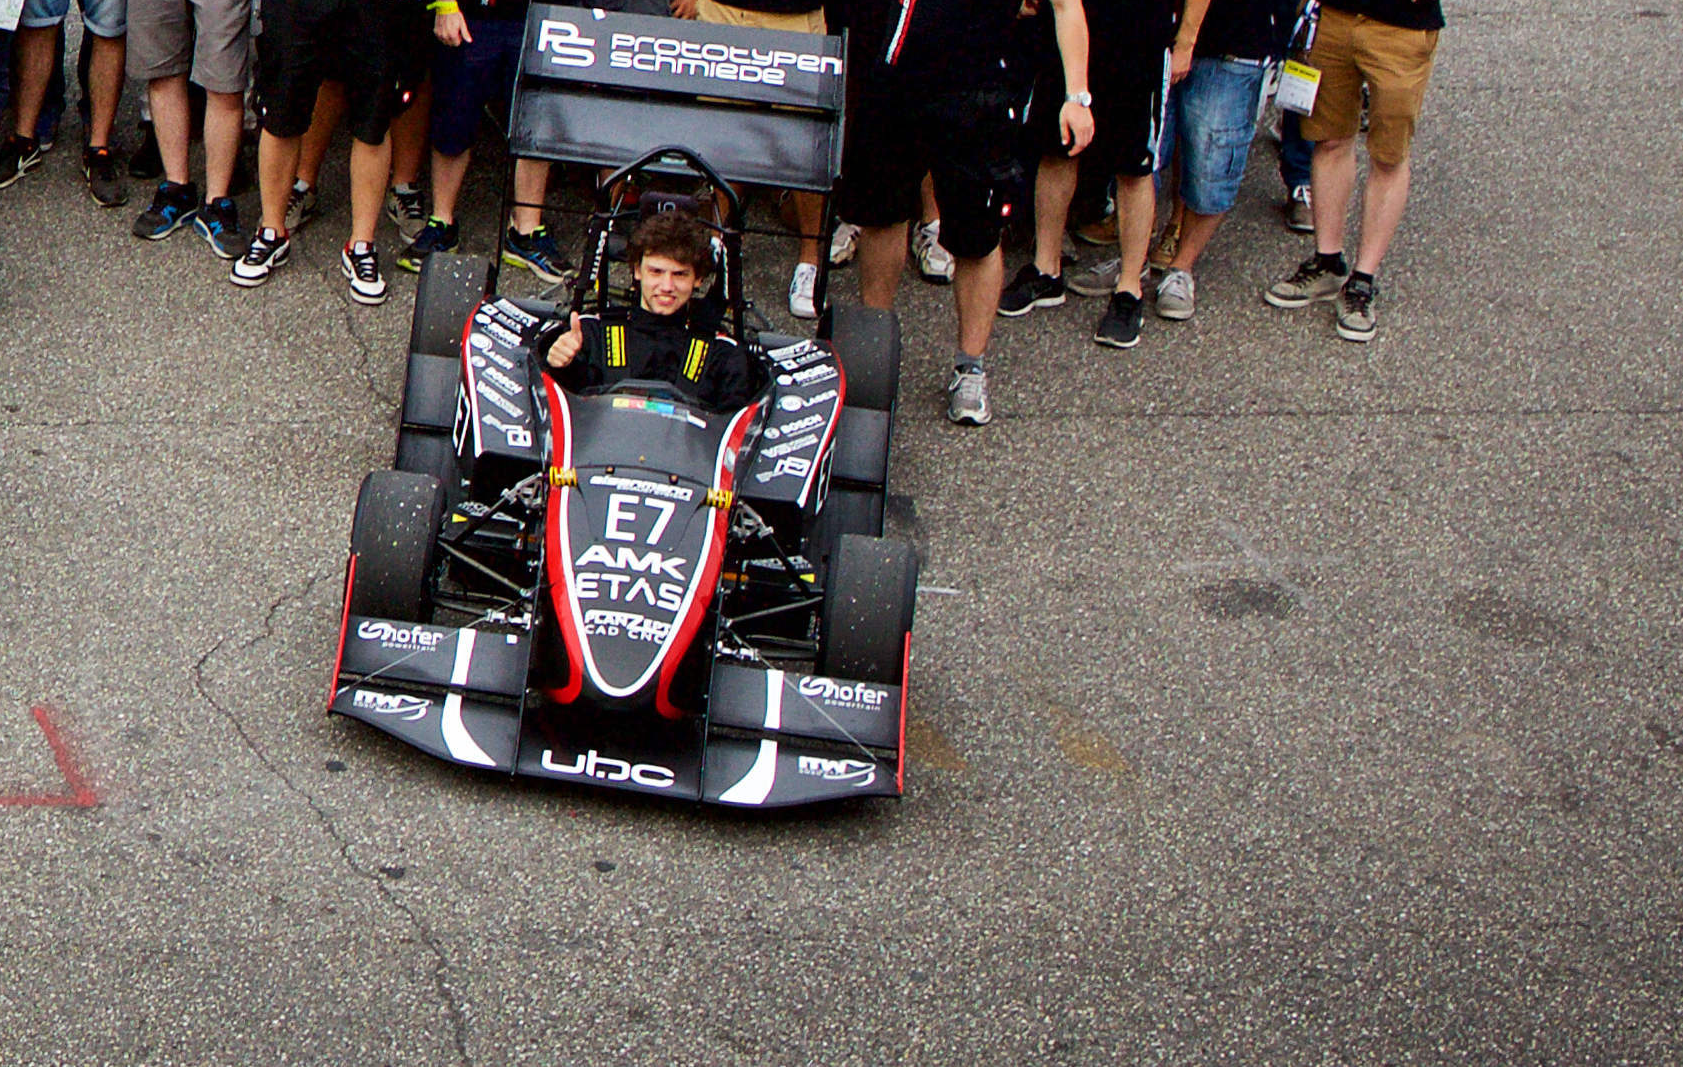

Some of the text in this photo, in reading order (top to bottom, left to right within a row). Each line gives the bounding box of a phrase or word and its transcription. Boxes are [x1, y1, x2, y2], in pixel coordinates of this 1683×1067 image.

[780, 413, 823, 433] BOSCH
[605, 493, 676, 546] E7
[575, 544, 687, 582] AMK
[381, 622, 444, 646] hofer
[584, 624, 666, 645] CAD CNC
[823, 680, 889, 705] hofer
[824, 698, 882, 712] powertrain
[540, 749, 675, 788] ubc
